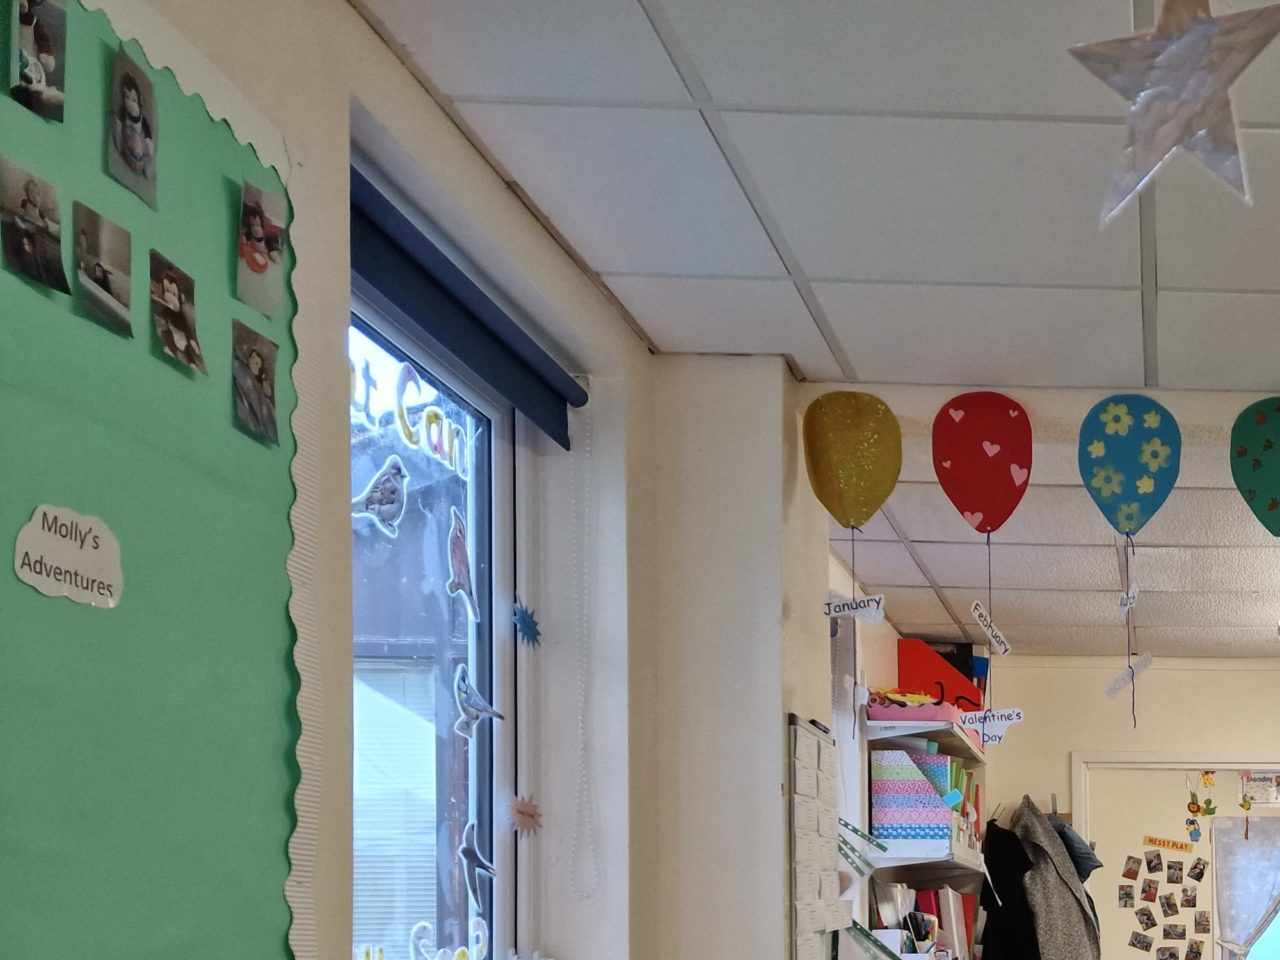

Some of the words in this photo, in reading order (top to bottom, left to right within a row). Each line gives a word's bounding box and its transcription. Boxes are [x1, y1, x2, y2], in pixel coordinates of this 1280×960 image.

[41, 511, 101, 550] Molly's
[20, 551, 114, 598] Adventures
[823, 597, 883, 616] January
[972, 602, 1011, 655] February
[960, 709, 1022, 726] Valentine's
[982, 733, 1003, 743] Day
